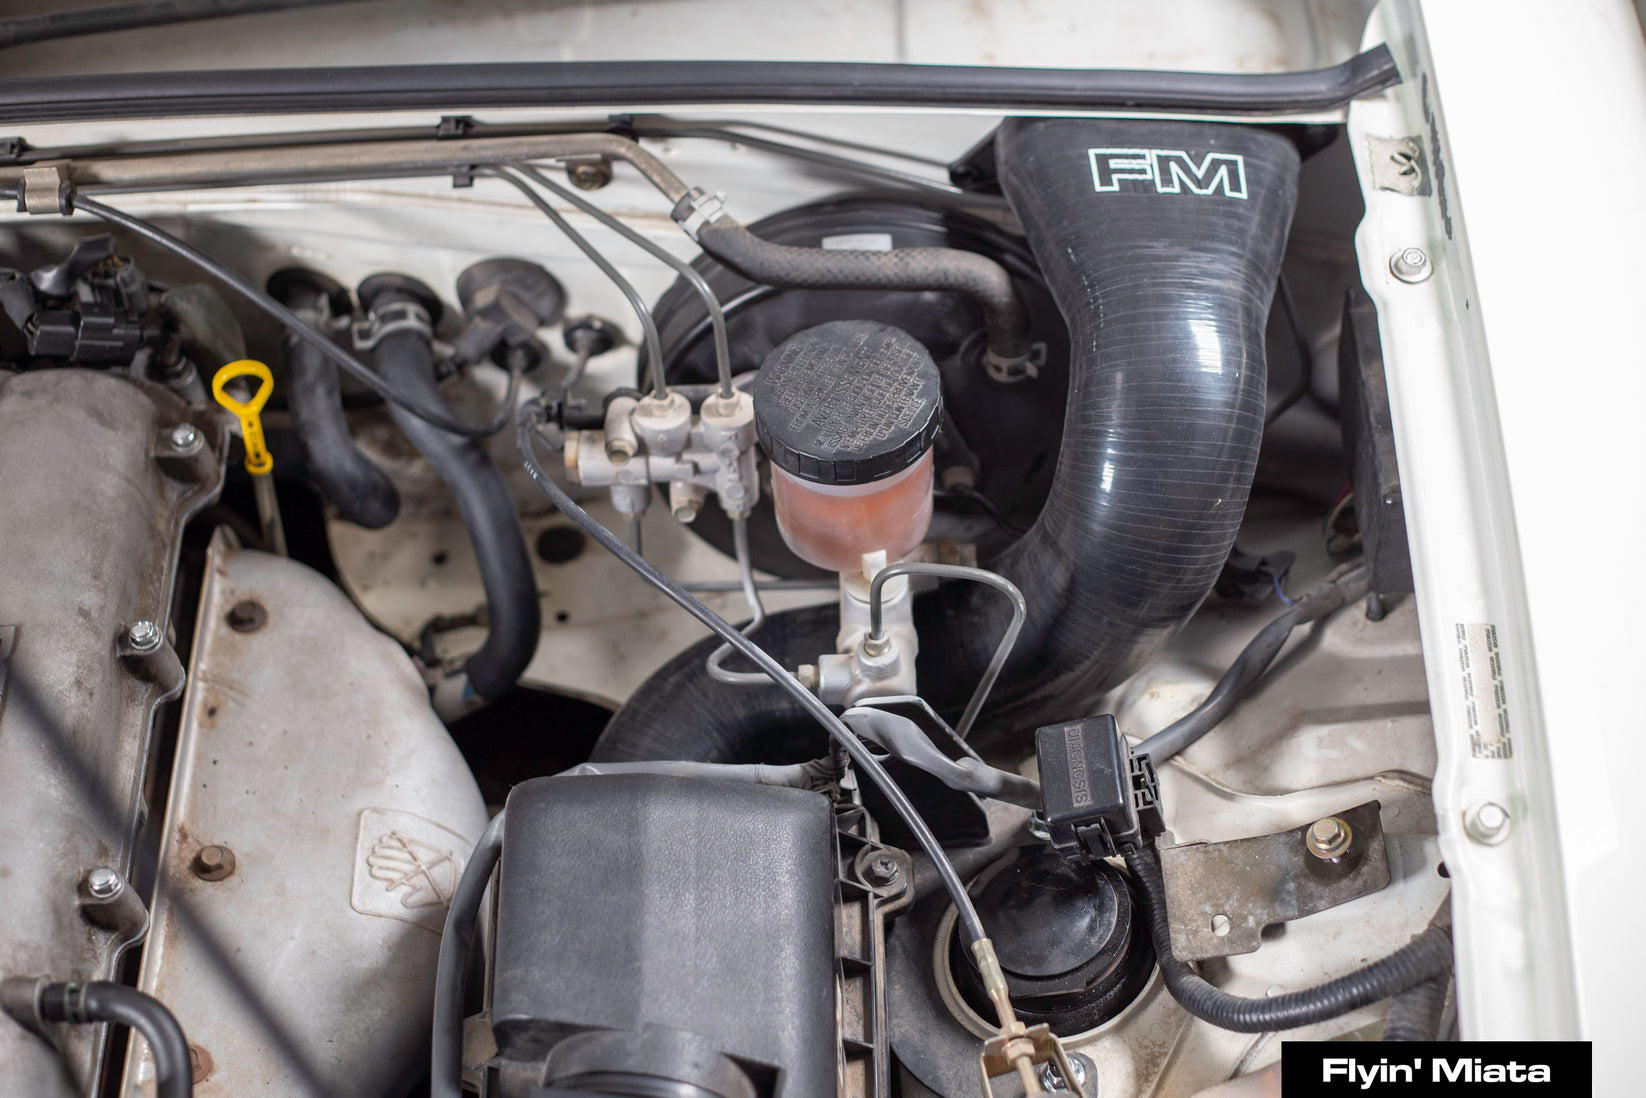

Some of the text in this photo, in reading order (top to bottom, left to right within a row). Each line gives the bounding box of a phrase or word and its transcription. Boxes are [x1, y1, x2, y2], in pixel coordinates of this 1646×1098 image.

[1087, 148, 1248, 199] FM
[810, 348, 877, 426] AVERTISSEMENT
[1067, 728, 1089, 804] DIAGNOSIS
